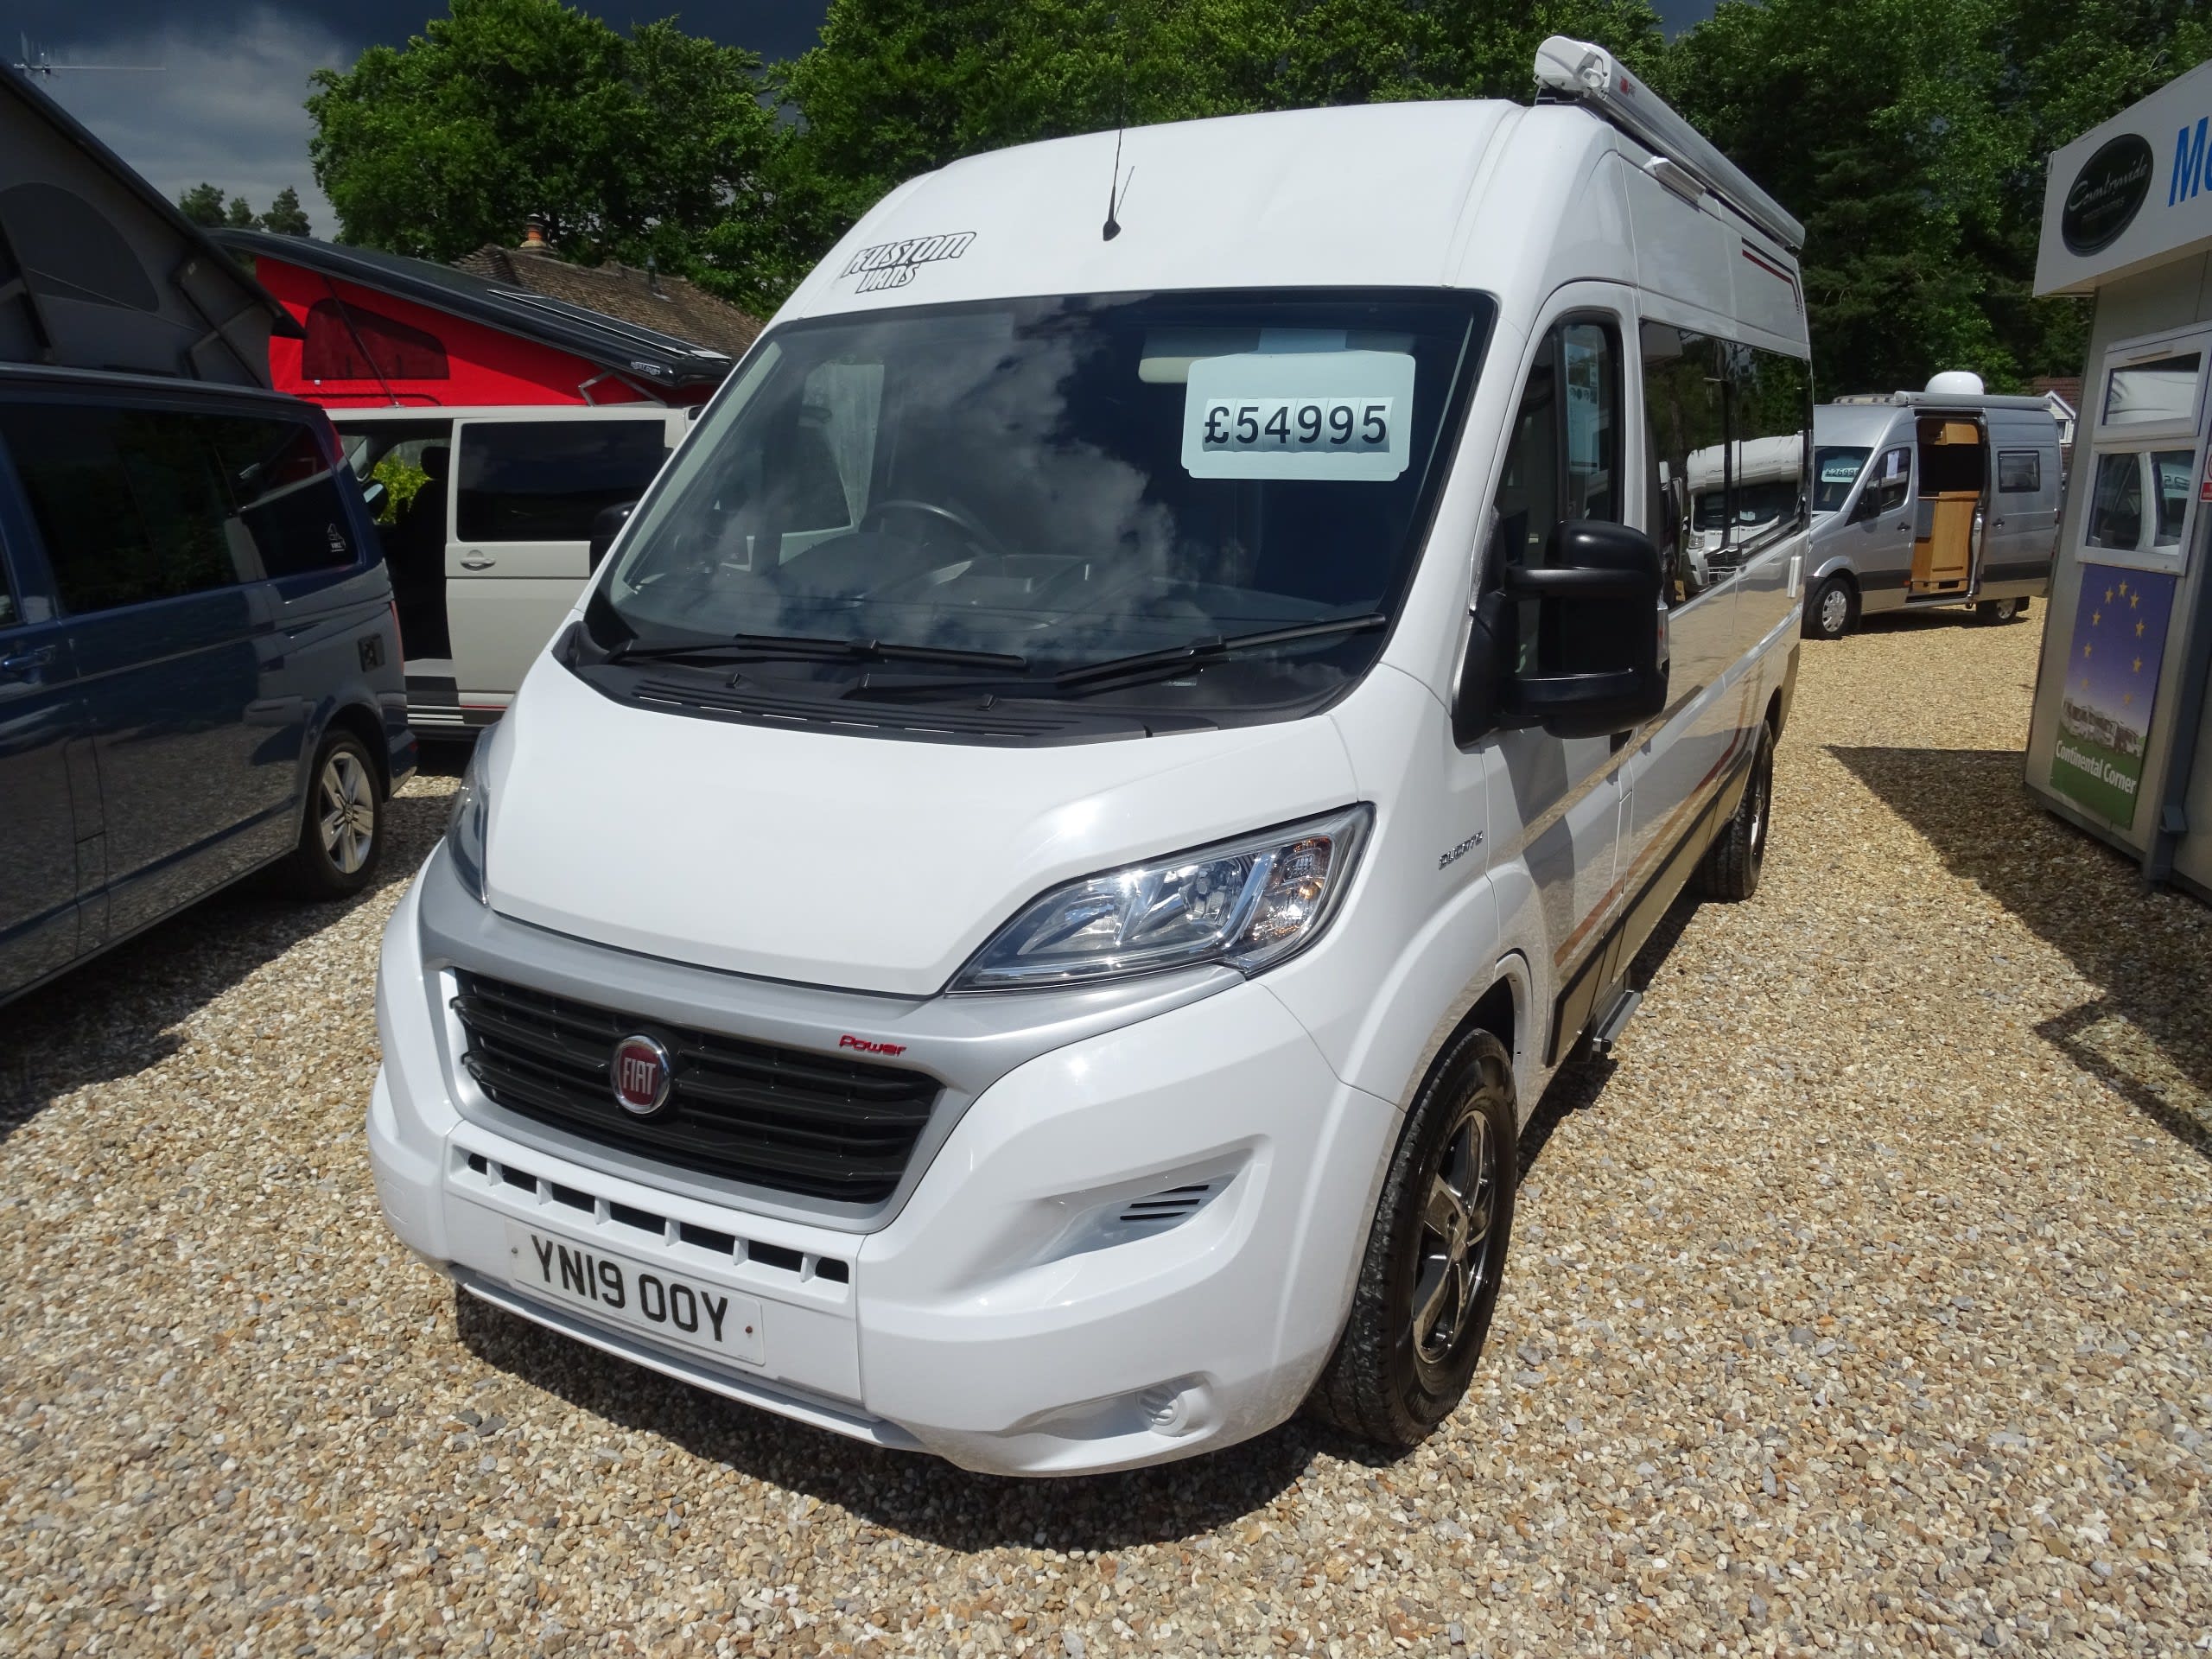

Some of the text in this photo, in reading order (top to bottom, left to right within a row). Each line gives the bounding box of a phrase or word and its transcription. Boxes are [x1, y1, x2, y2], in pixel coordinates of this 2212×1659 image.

[2168, 115, 2212, 207] M
[1205, 405, 1387, 444] £54995
[2056, 740, 2137, 795] Continental Corner
[839, 1035, 906, 1057] Power
[622, 1056, 657, 1096] FIAT
[531, 1234, 626, 1309] YN19
